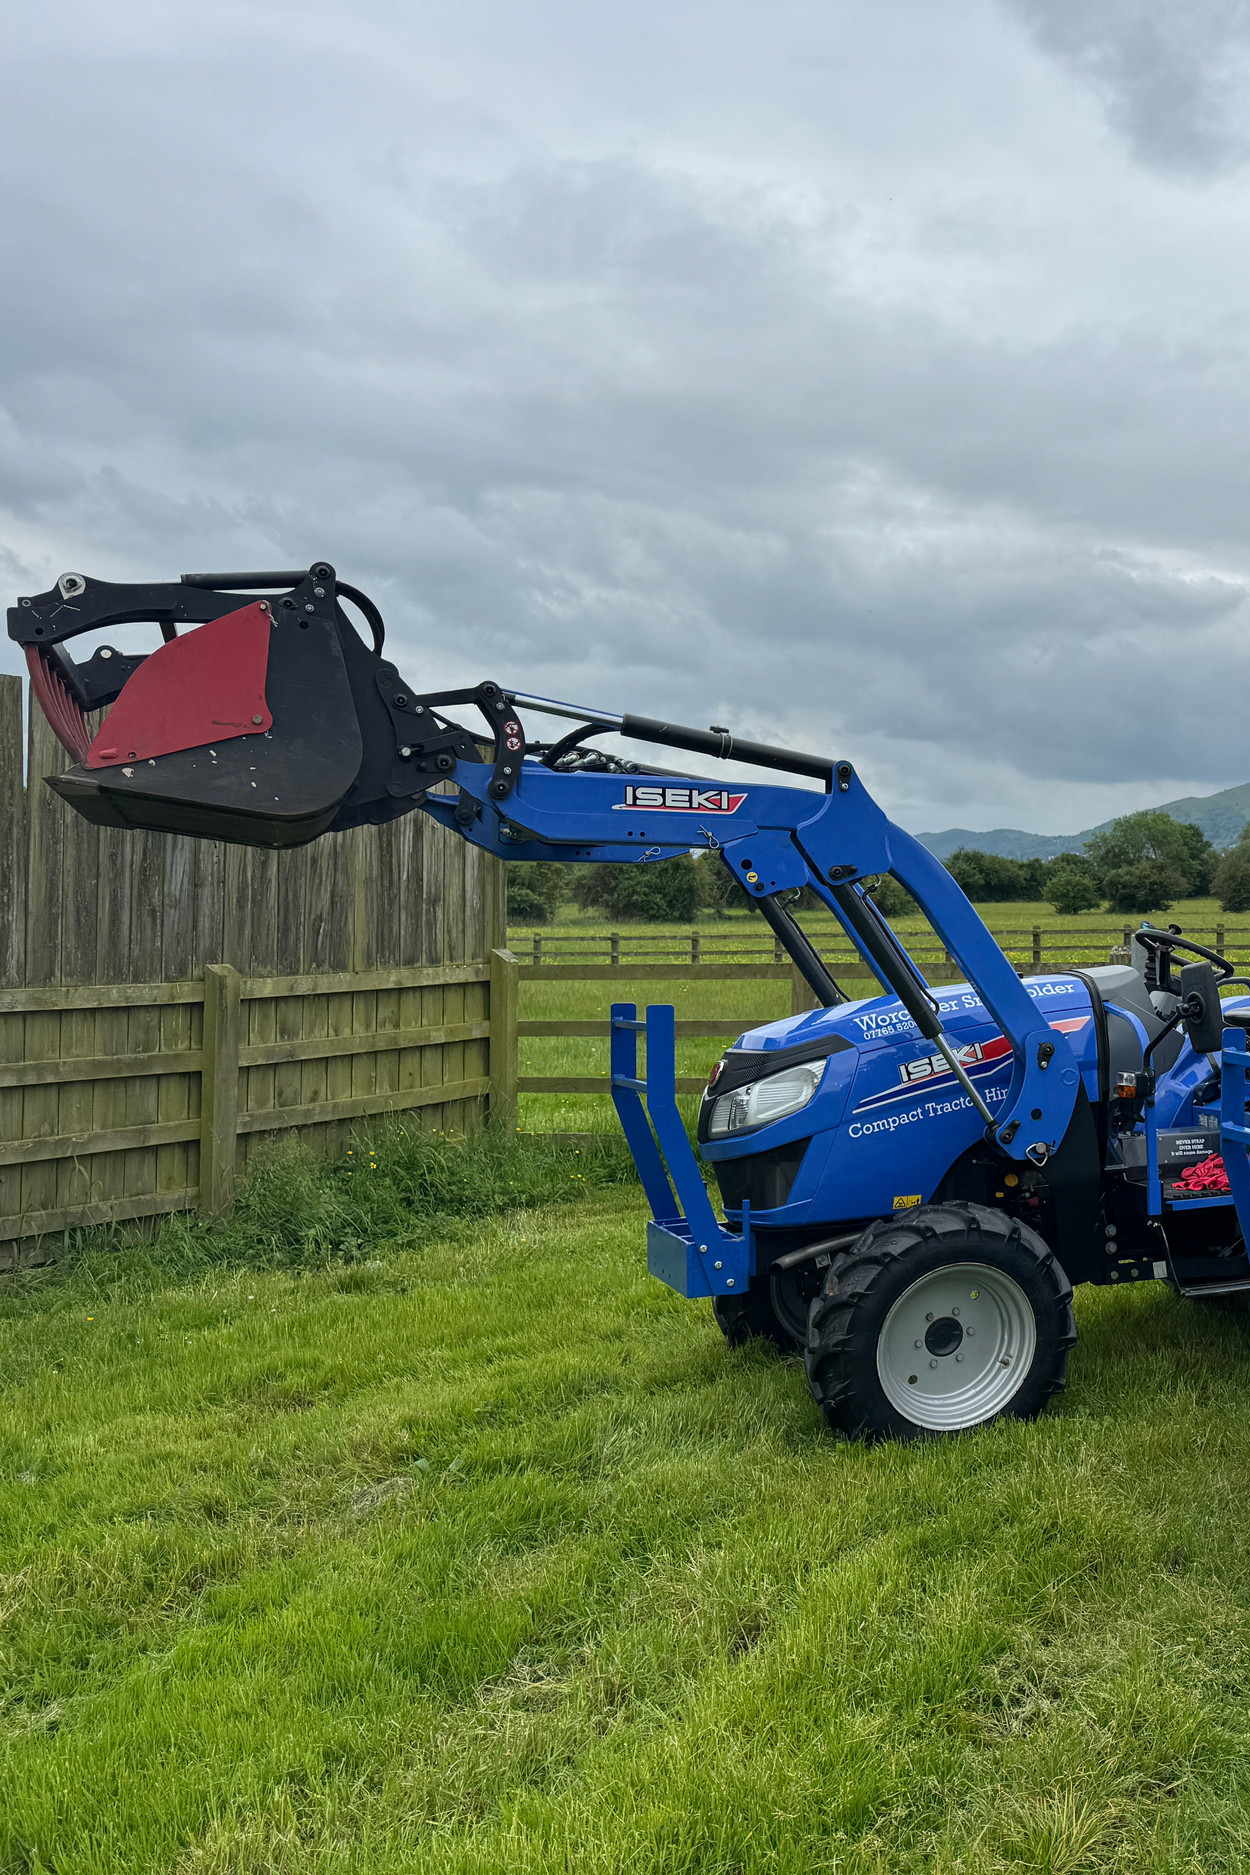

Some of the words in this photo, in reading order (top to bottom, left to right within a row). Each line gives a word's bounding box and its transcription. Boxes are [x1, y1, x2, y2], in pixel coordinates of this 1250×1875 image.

[625, 785, 729, 810] ISEKI
[863, 1025, 894, 1041] 07765
[898, 1042, 984, 1083] ISEKI
[848, 1107, 924, 1138] Compact
[925, 1096, 974, 1118] Tracto
[984, 1086, 1009, 1103] Hir
